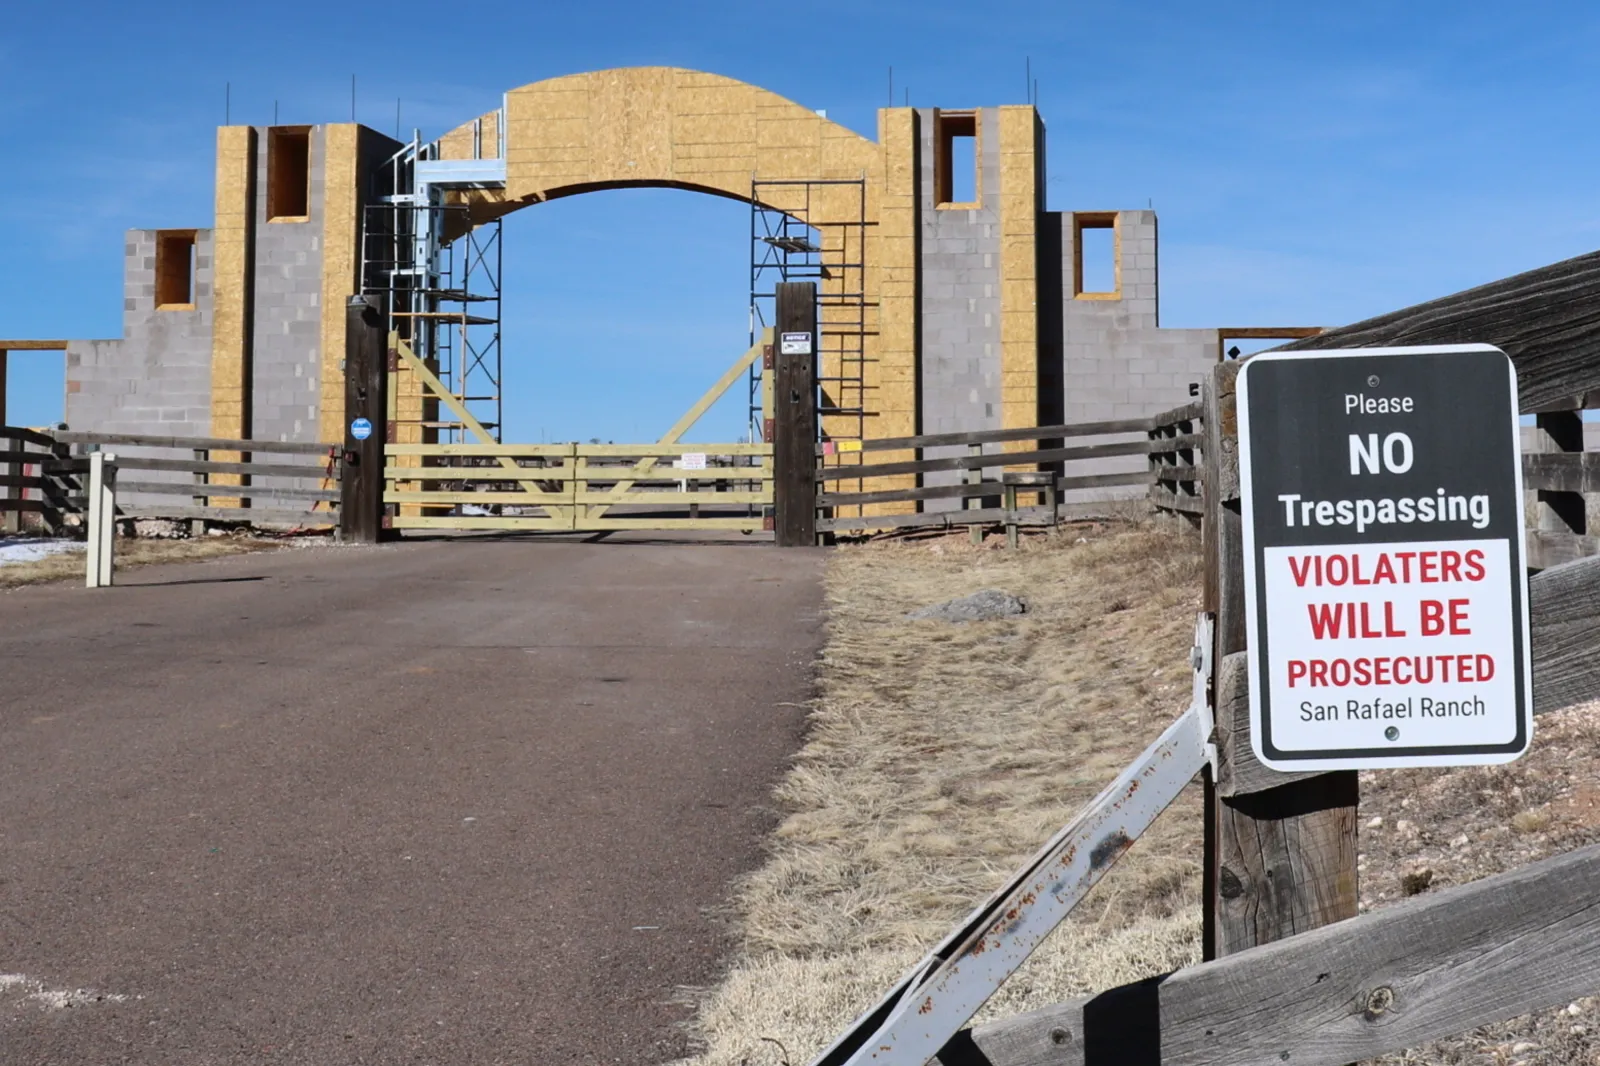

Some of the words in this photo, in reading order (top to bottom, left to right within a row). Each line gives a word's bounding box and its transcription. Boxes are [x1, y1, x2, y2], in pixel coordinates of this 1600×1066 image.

[1345, 393, 1414, 414] Please
[1349, 432, 1414, 475] NO
[1278, 488, 1490, 533] Trespassing
[1288, 549, 1486, 587] VIOLATERS
[1308, 601, 1406, 640] WILL
[1420, 598, 1471, 636] BE
[1288, 654, 1495, 688] PROSECUTED
[1299, 701, 1339, 722] San
[1347, 697, 1412, 720] Rafael
[1421, 695, 1485, 718] Ranch
